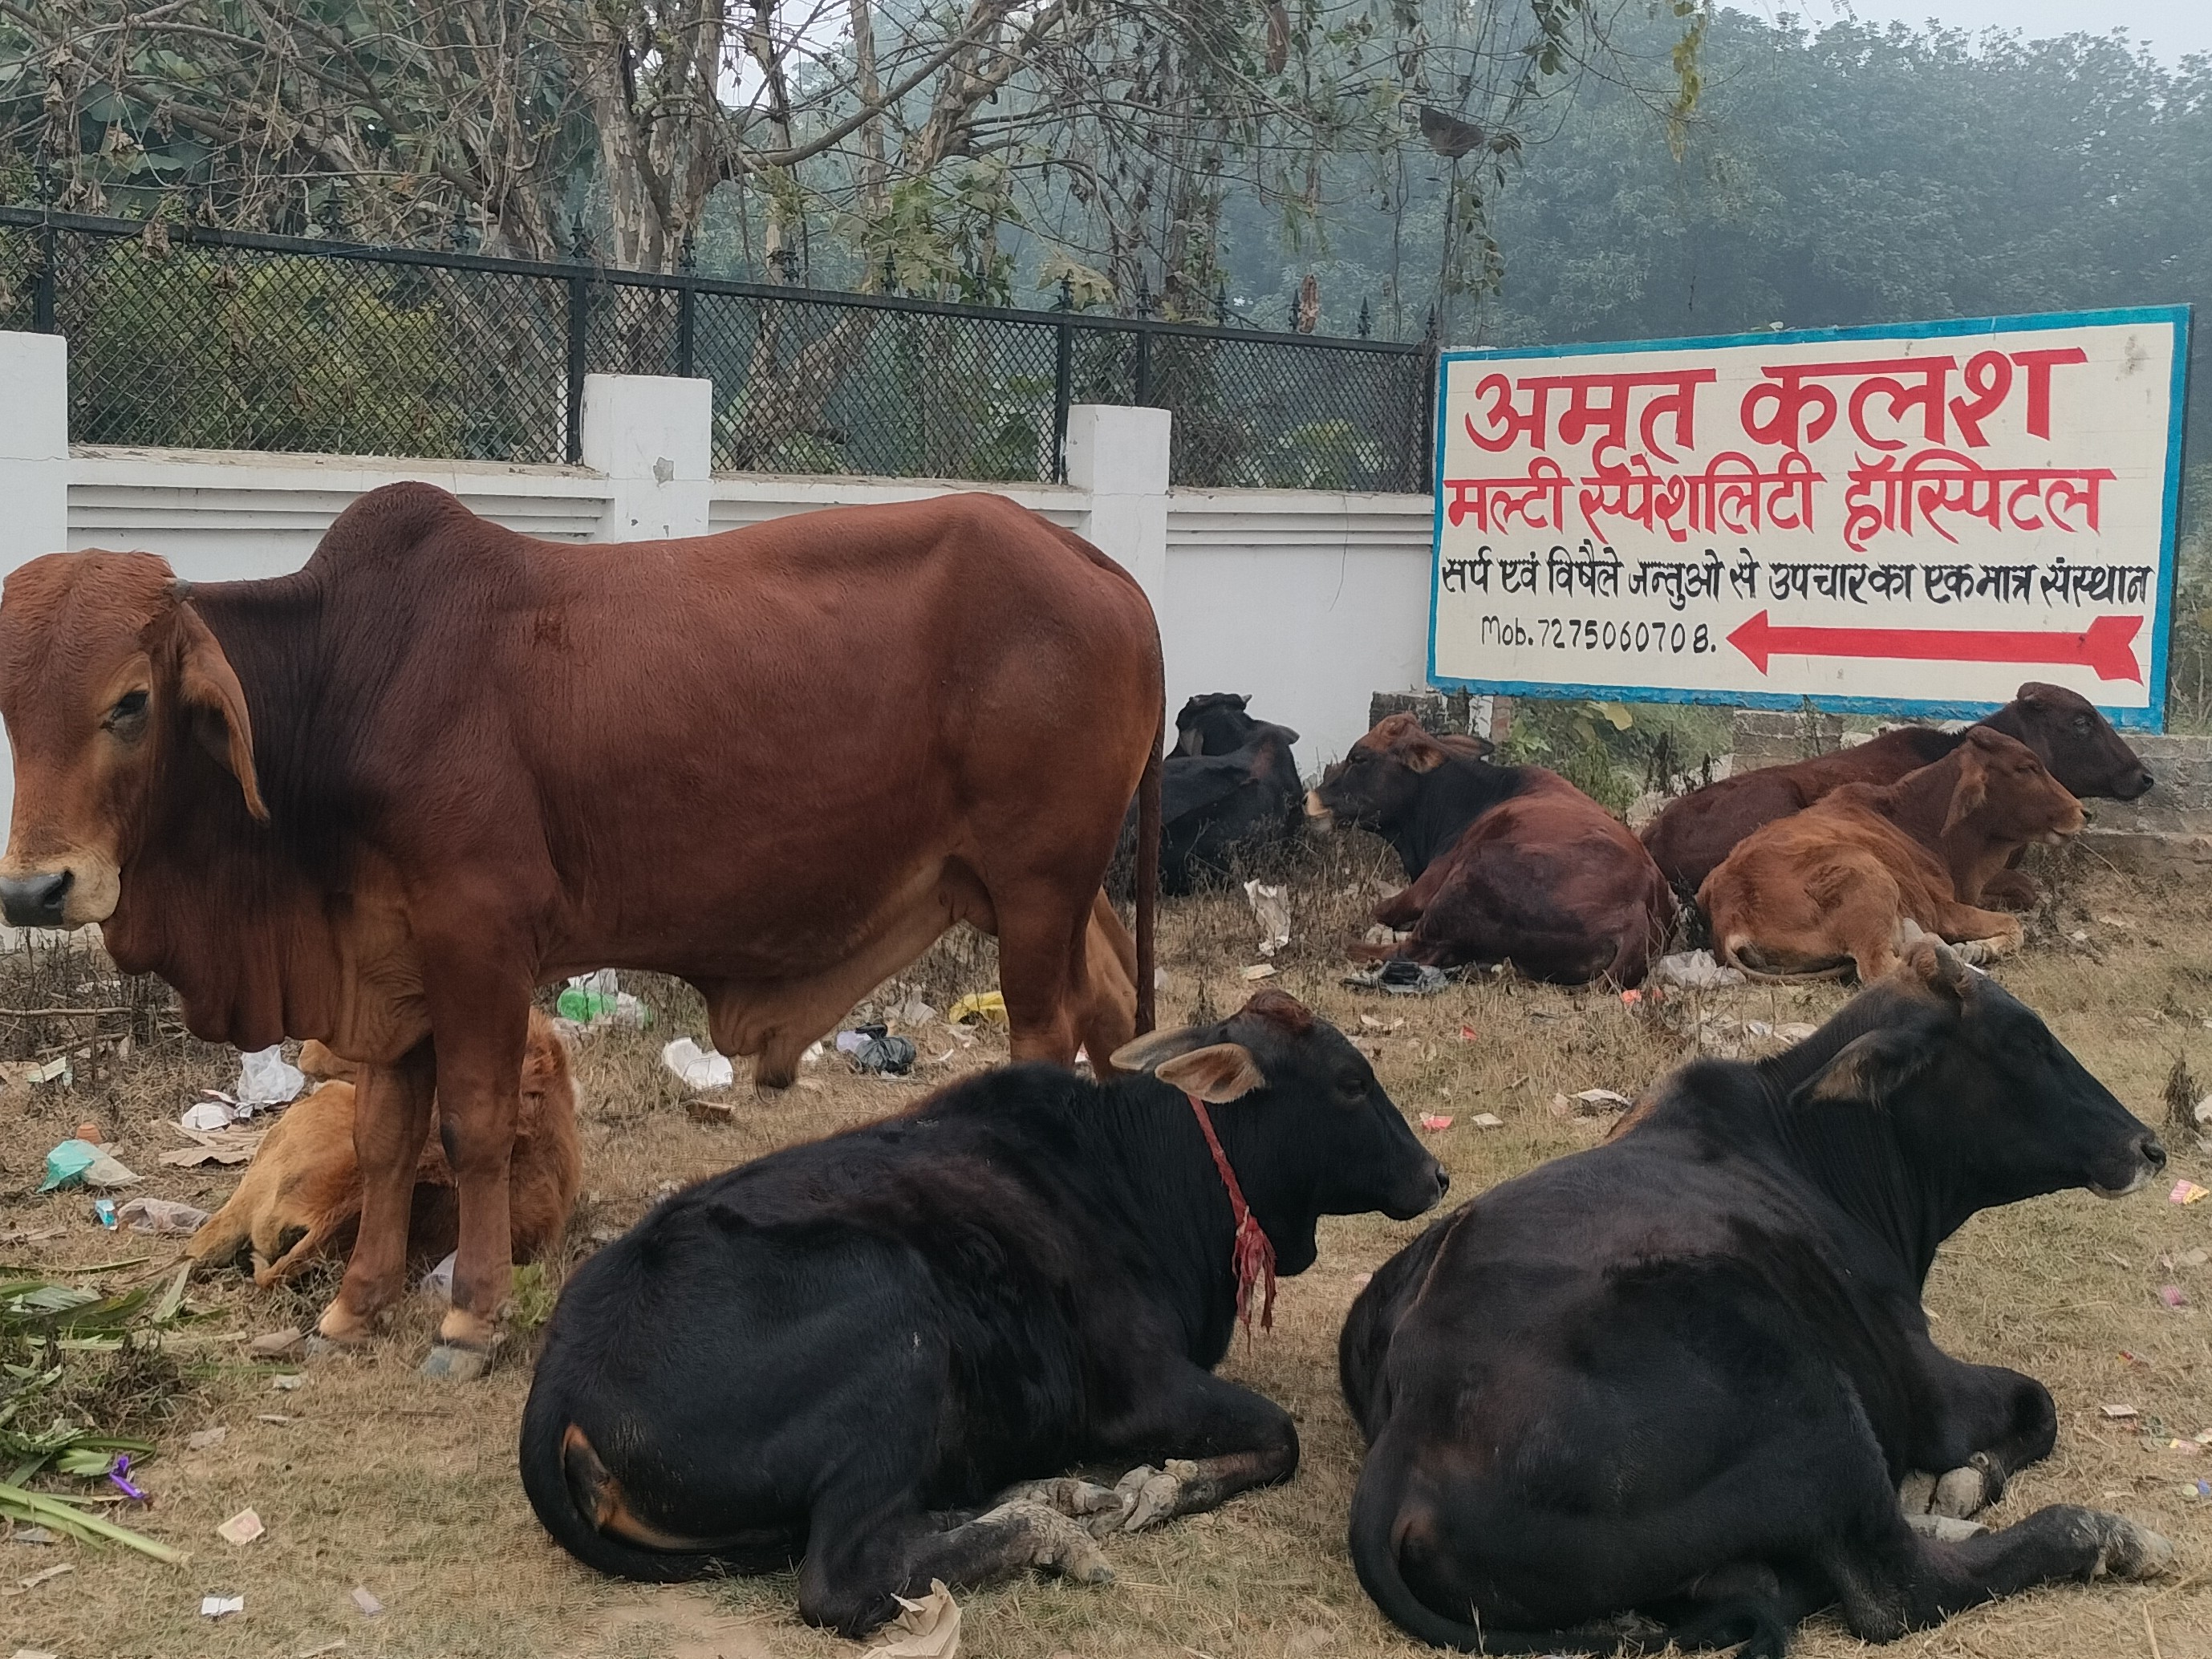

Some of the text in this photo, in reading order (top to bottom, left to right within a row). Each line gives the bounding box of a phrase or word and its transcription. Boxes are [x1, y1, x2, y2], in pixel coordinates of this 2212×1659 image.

[1465, 347, 2088, 477] अमृत कलश
[1443, 449, 2117, 552] मल्टी स्पेशलिटी हॉस्पिटल
[1442, 546, 1494, 594] सर्प
[1497, 551, 1541, 596] एवं
[1546, 538, 1625, 598] विषैले
[1729, 547, 1762, 600] से
[2040, 556, 2156, 608] संस्थान
